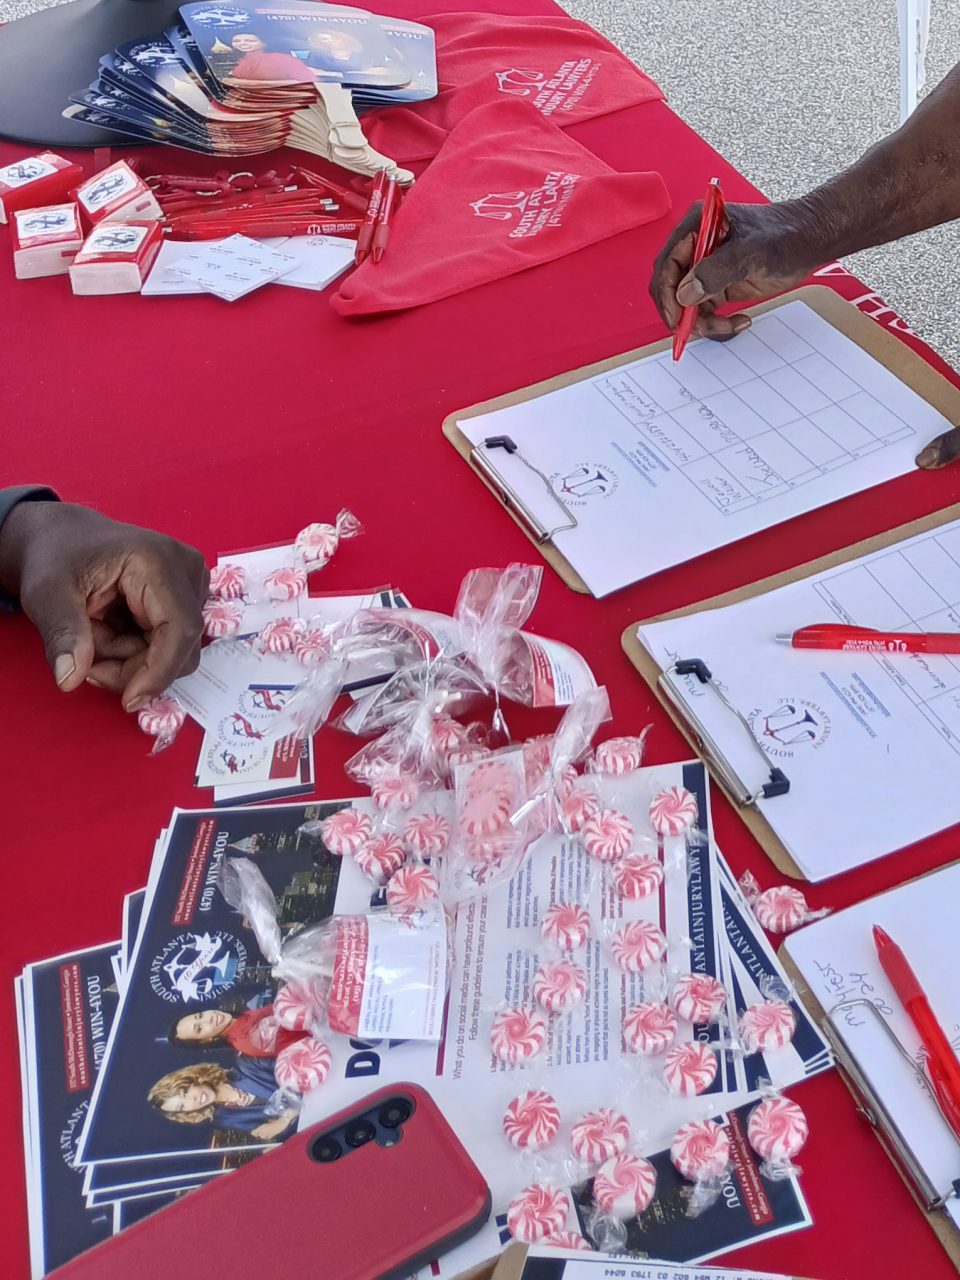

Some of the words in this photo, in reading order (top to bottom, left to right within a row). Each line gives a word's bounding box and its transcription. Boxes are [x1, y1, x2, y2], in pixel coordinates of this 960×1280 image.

[198, 885, 216, 912] (470)
[464, 901, 475, 922] effects
[478, 903, 487, 917] case
[477, 918, 488, 933] your
[461, 922, 476, 952] profound
[476, 934, 485, 955] ensure
[150, 932, 194, 972] ATLANTA
[460, 953, 472, 969] have
[474, 956, 483, 964] to
[462, 969, 471, 981] can
[470, 965, 485, 998] guidelines
[150, 975, 180, 1003] SOUTH
[458, 982, 470, 1003] media
[87, 975, 104, 1039] WIN-4YOU
[457, 1004, 468, 1024] social
[469, 998, 481, 1018] these
[458, 1025, 467, 1034] on
[468, 1018, 479, 1040] Follow
[455, 1034, 466, 1045] do
[455, 1046, 467, 1058] you
[452, 1059, 464, 1080] What
[719, 1176, 740, 1209] YOU
[604, 1268, 625, 1276] 6044
[631, 1270, 650, 1278] 1793
